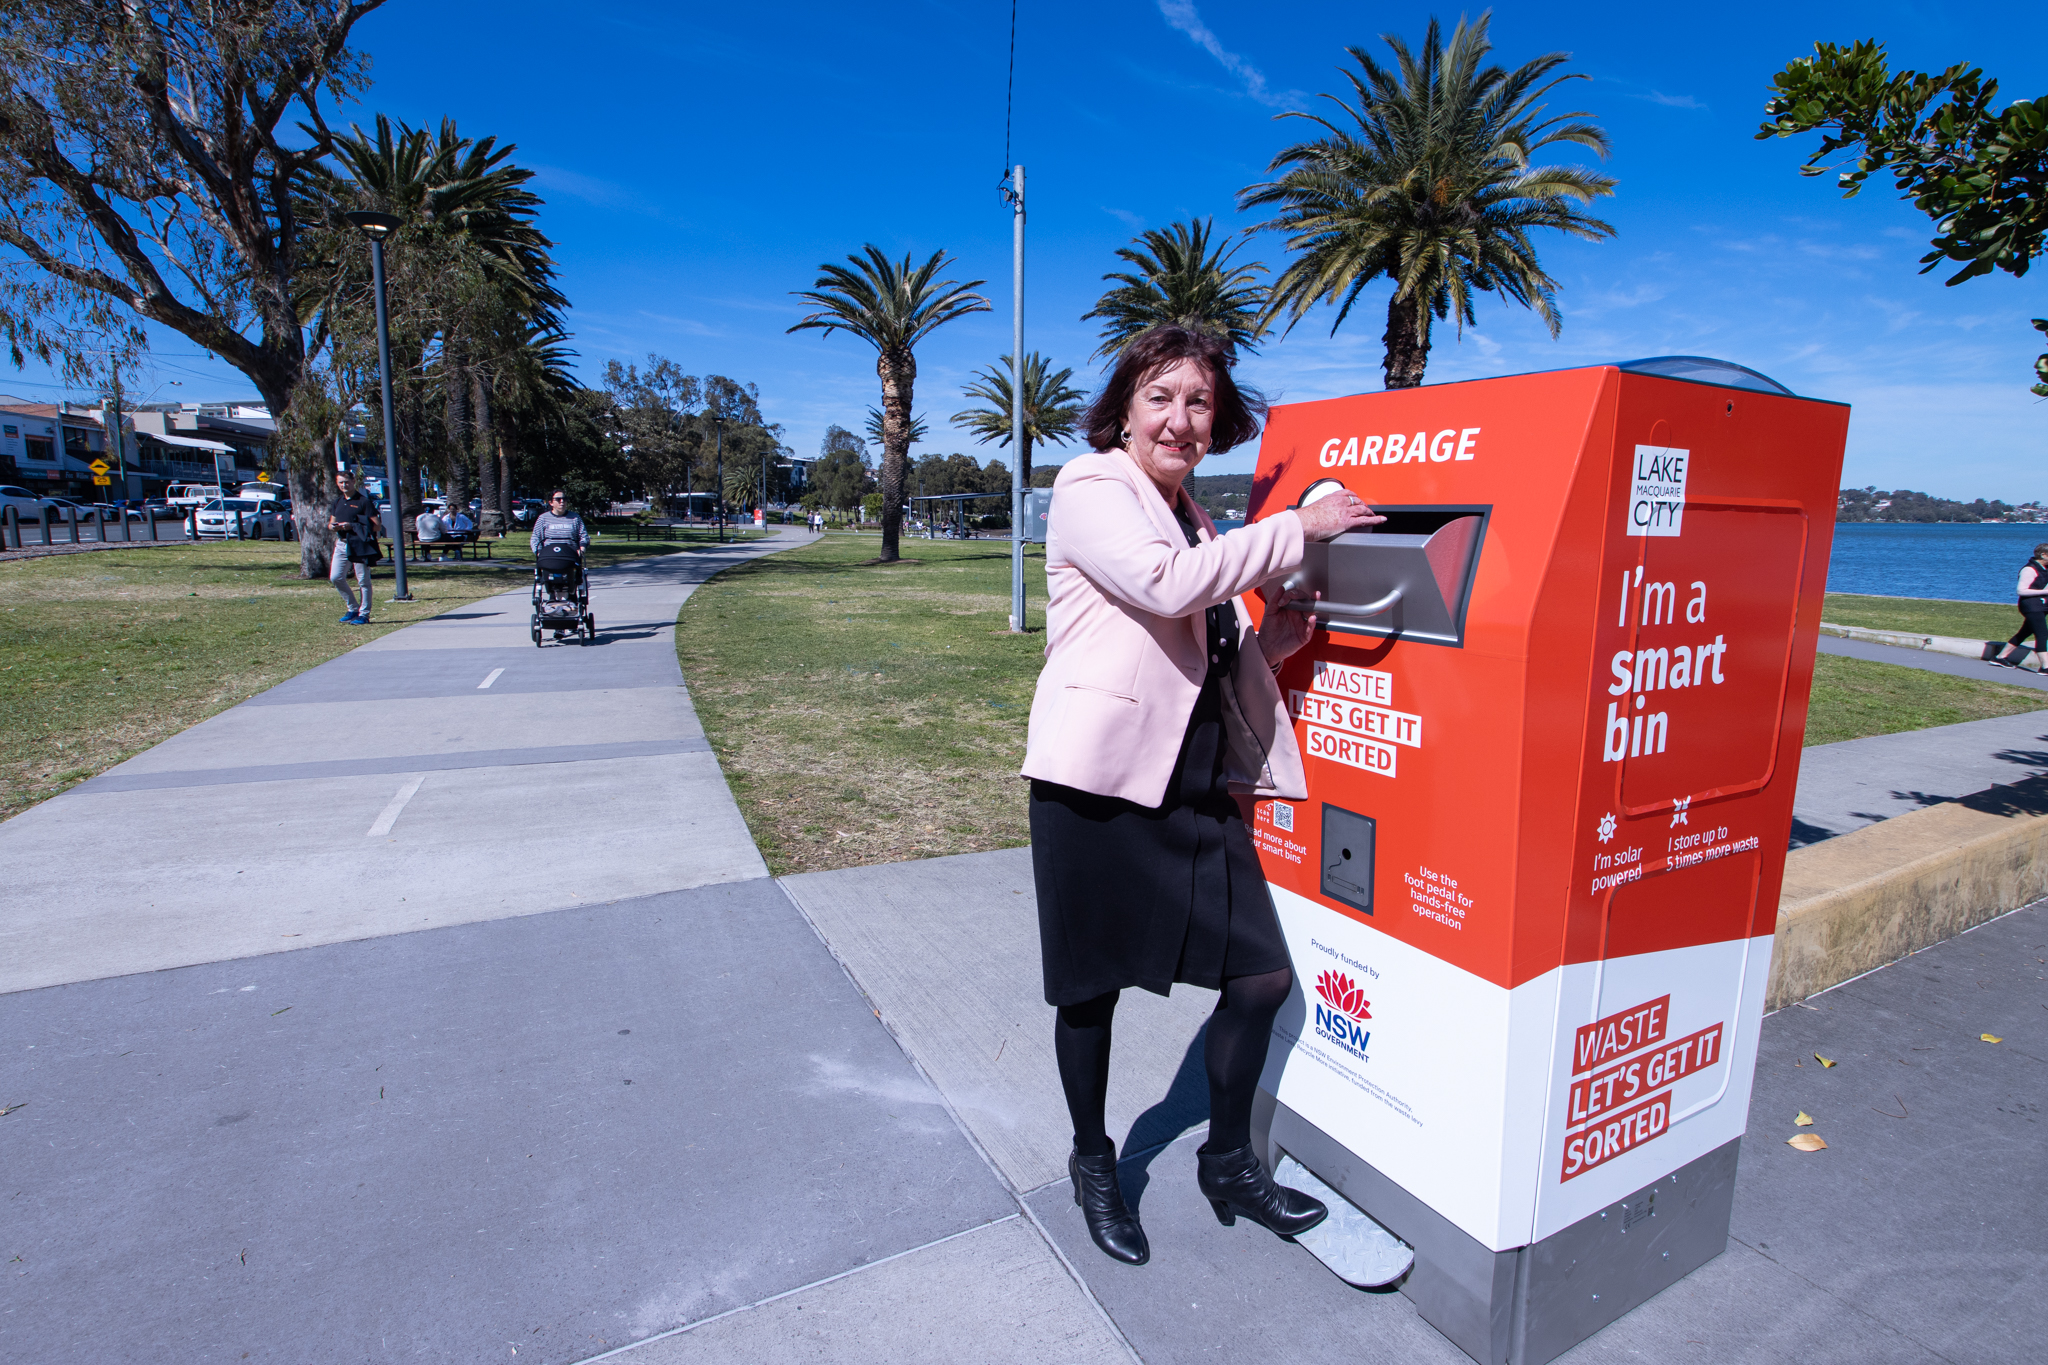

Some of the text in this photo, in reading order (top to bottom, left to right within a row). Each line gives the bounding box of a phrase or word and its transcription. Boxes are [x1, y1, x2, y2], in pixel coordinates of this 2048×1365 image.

[1319, 427, 1481, 468] GARBAGE
[1637, 454, 1684, 483] LAKE
[1636, 484, 1681, 498] MACQUARIE
[1633, 500, 1680, 527] CITY
[1618, 565, 1707, 627] I'm a
[1607, 634, 1727, 696] smart
[1318, 667, 1386, 699] WASTE
[1292, 693, 1417, 742] LET'S GET IT
[1602, 695, 1668, 762] bin
[1310, 731, 1392, 770] SORTED
[1256, 807, 1270, 816] scan
[1256, 813, 1270, 823] here
[1262, 842, 1284, 857] smart
[1285, 849, 1301, 864] bins
[1263, 832, 1283, 845] more
[1284, 839, 1307, 855] about
[1666, 835, 1759, 872] 5 times more waste
[1673, 833, 1701, 852] store
[1702, 829, 1716, 845] up
[1717, 825, 1728, 840] to
[1593, 845, 1643, 871] I'm solar
[1404, 872, 1474, 908] foot pedal for
[1420, 865, 1458, 889] Use the
[1591, 863, 1643, 895] powered
[1410, 887, 1466, 918] hands-free
[1412, 903, 1462, 931] operation
[1311, 938, 1380, 980] Proudly funded by
[1315, 1026, 1370, 1063] GOVERNMENT
[1316, 1003, 1371, 1052] NSW
[1579, 1003, 1662, 1067] WASTE
[1315, 1055, 1329, 1068] More
[1351, 1077, 1370, 1093] funded
[1370, 1089, 1384, 1102] from
[1384, 1098, 1393, 1108] the
[1394, 1105, 1411, 1119] waste
[1358, 1073, 1385, 1095] Protection
[1571, 1029, 1719, 1122] LET'S GET IT
[1564, 1101, 1666, 1175] SORTED
